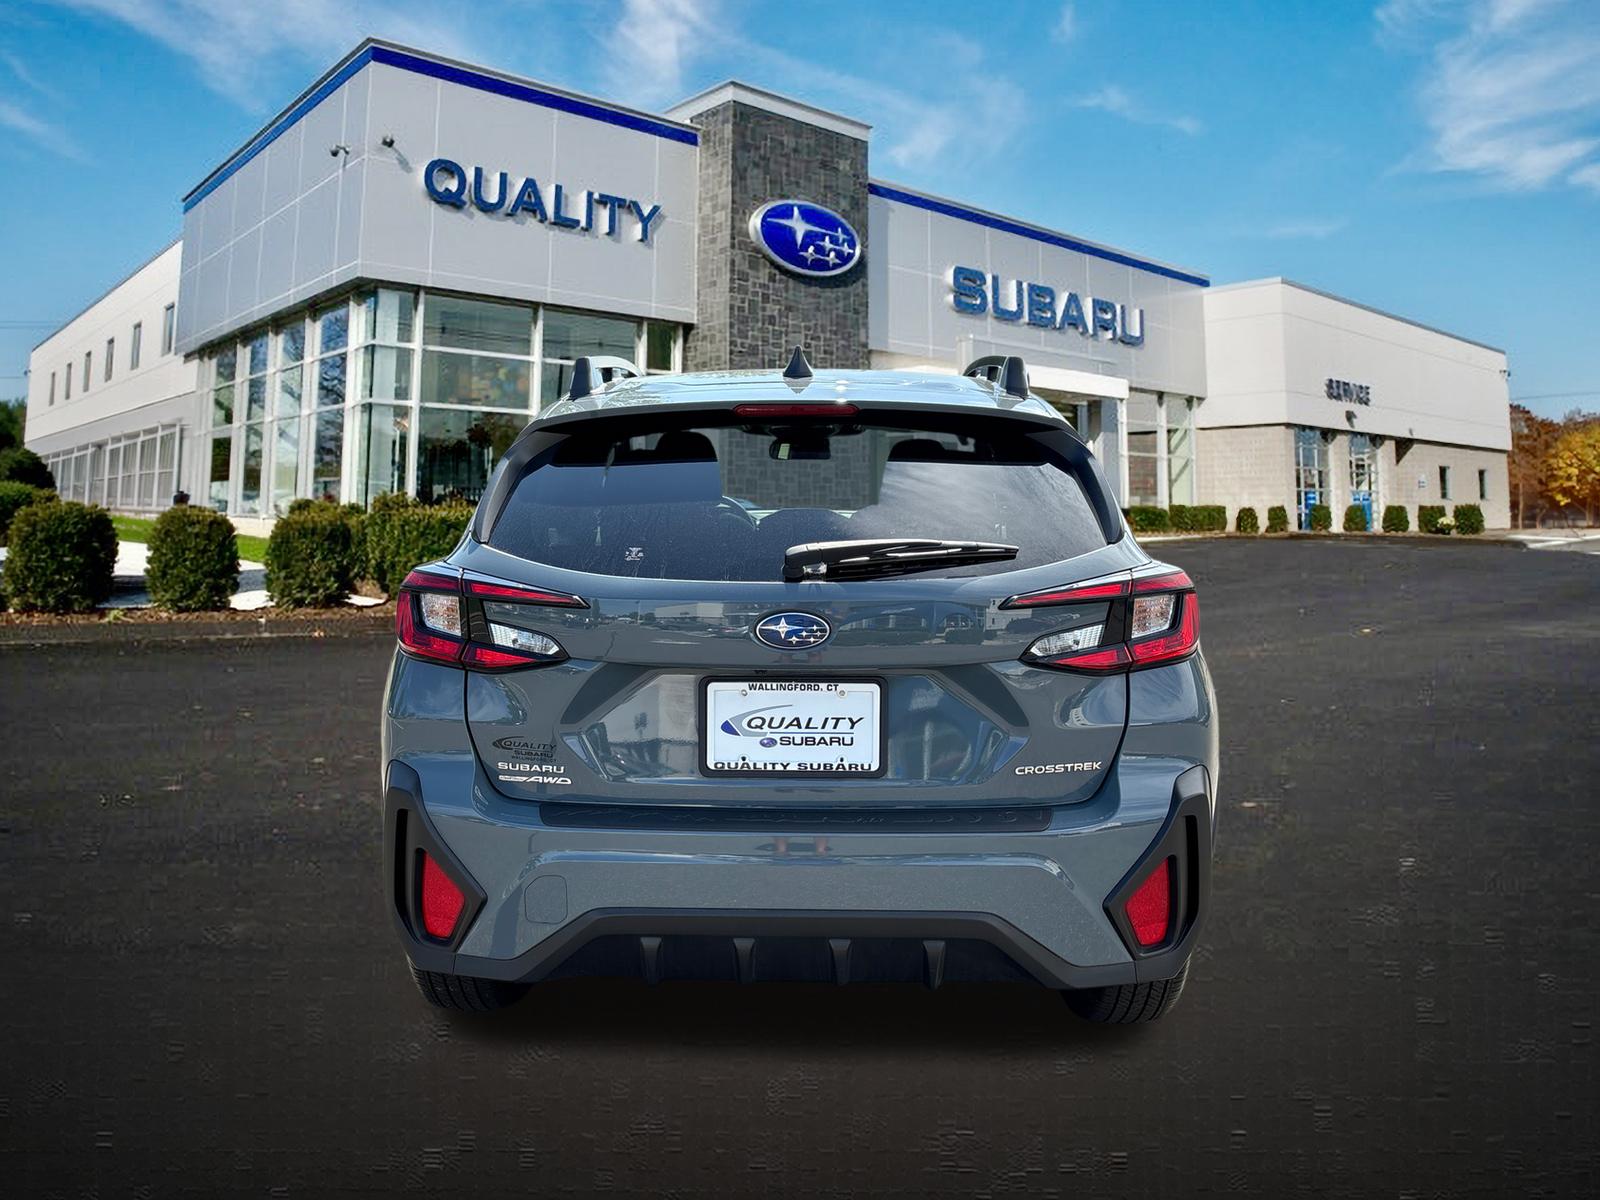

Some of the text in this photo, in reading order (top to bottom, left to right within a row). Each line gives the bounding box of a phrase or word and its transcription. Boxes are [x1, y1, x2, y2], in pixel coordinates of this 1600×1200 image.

[424, 158, 662, 242] QUALITY
[949, 265, 1145, 347] SUBARU
[1325, 378, 1371, 406] SERVICE
[826, 683, 839, 692] CT
[746, 716, 865, 730] QUALITY
[503, 740, 557, 751] QUALITY
[779, 736, 854, 747] SUBARU
[514, 750, 554, 758] SUBARU
[497, 762, 565, 774] SUBARU
[713, 761, 792, 770] QUALITY
[797, 762, 872, 771] SUBARU
[1015, 761, 1102, 775] CROSSTREK
[526, 775, 572, 785] AWD
